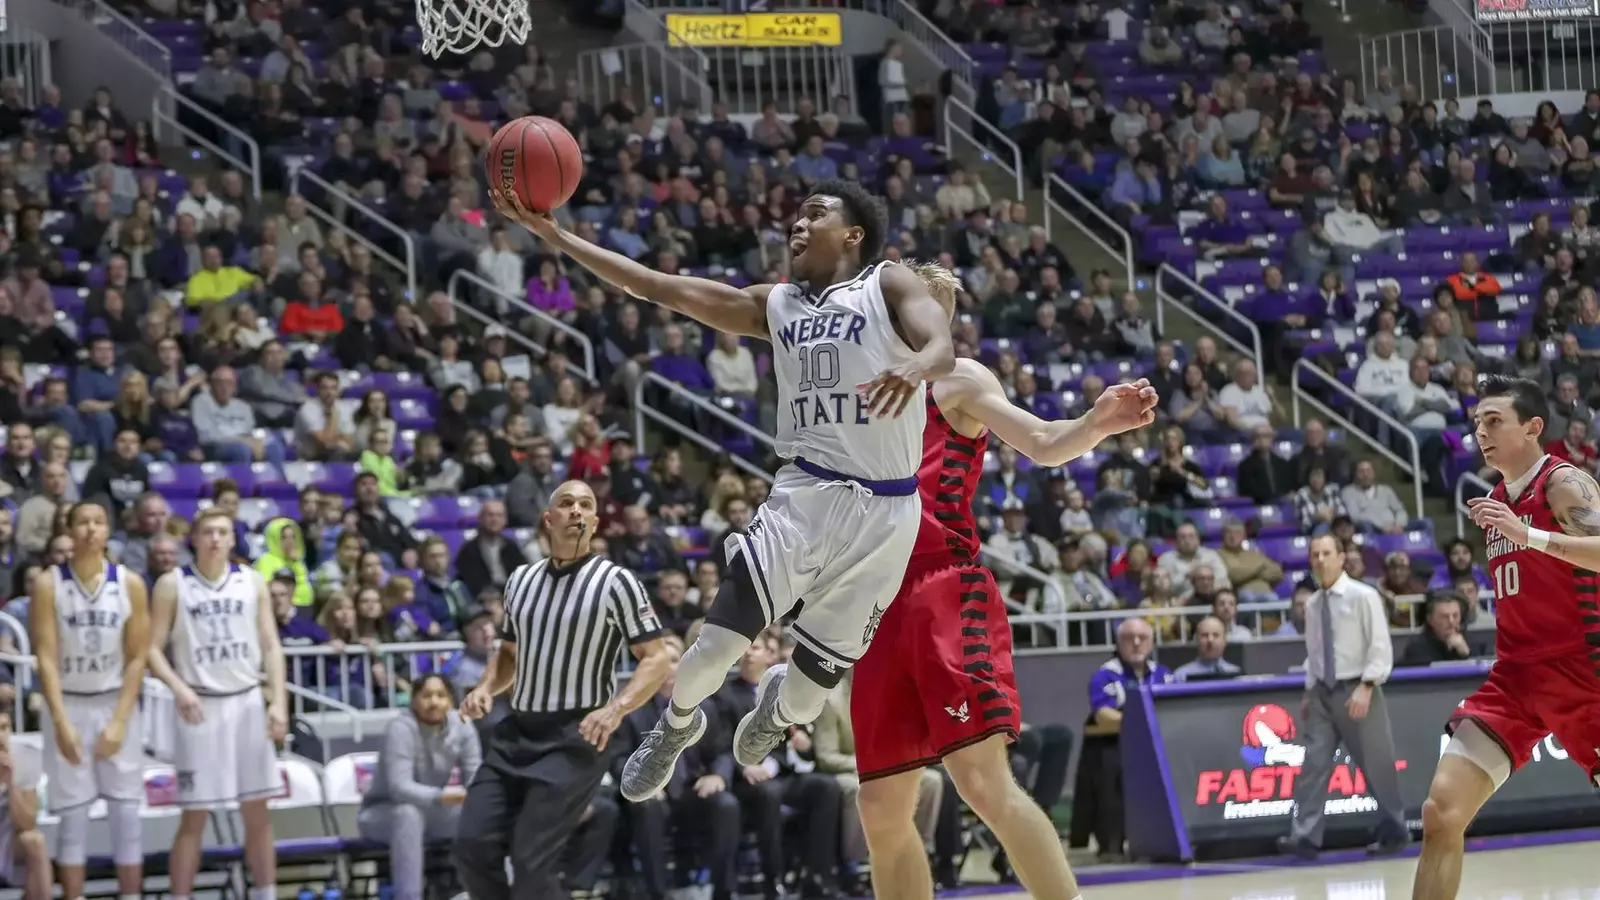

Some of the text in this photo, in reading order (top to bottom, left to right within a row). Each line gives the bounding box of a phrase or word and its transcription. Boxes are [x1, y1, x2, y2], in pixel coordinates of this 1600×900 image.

[684, 21, 742, 41] Hertz
[763, 27, 831, 37] SALES
[774, 15, 818, 26] CAR
[777, 313, 866, 353] WEBER
[799, 342, 840, 392] 10
[1494, 561, 1520, 600] 10
[186, 597, 244, 620] WEBER
[208, 617, 234, 642] 11
